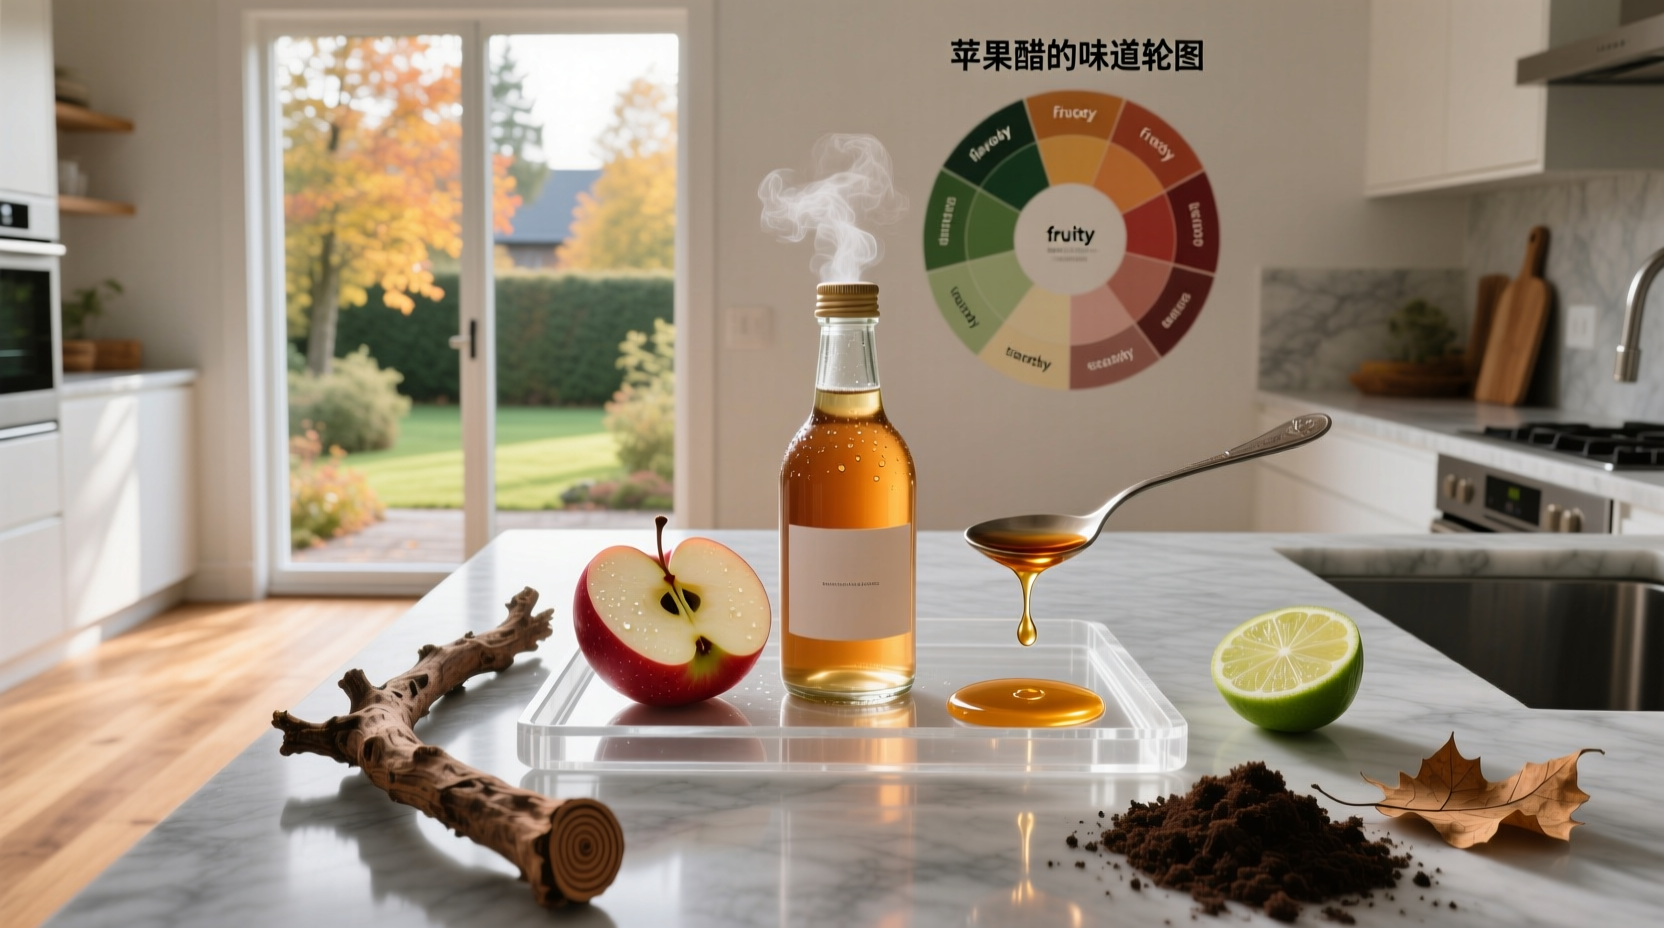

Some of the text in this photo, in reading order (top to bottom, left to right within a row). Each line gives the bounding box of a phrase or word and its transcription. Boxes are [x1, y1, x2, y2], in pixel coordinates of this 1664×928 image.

[950, 38, 1204, 72] 苹果醋的味道轮图
[1046, 225, 1096, 246] fruity
